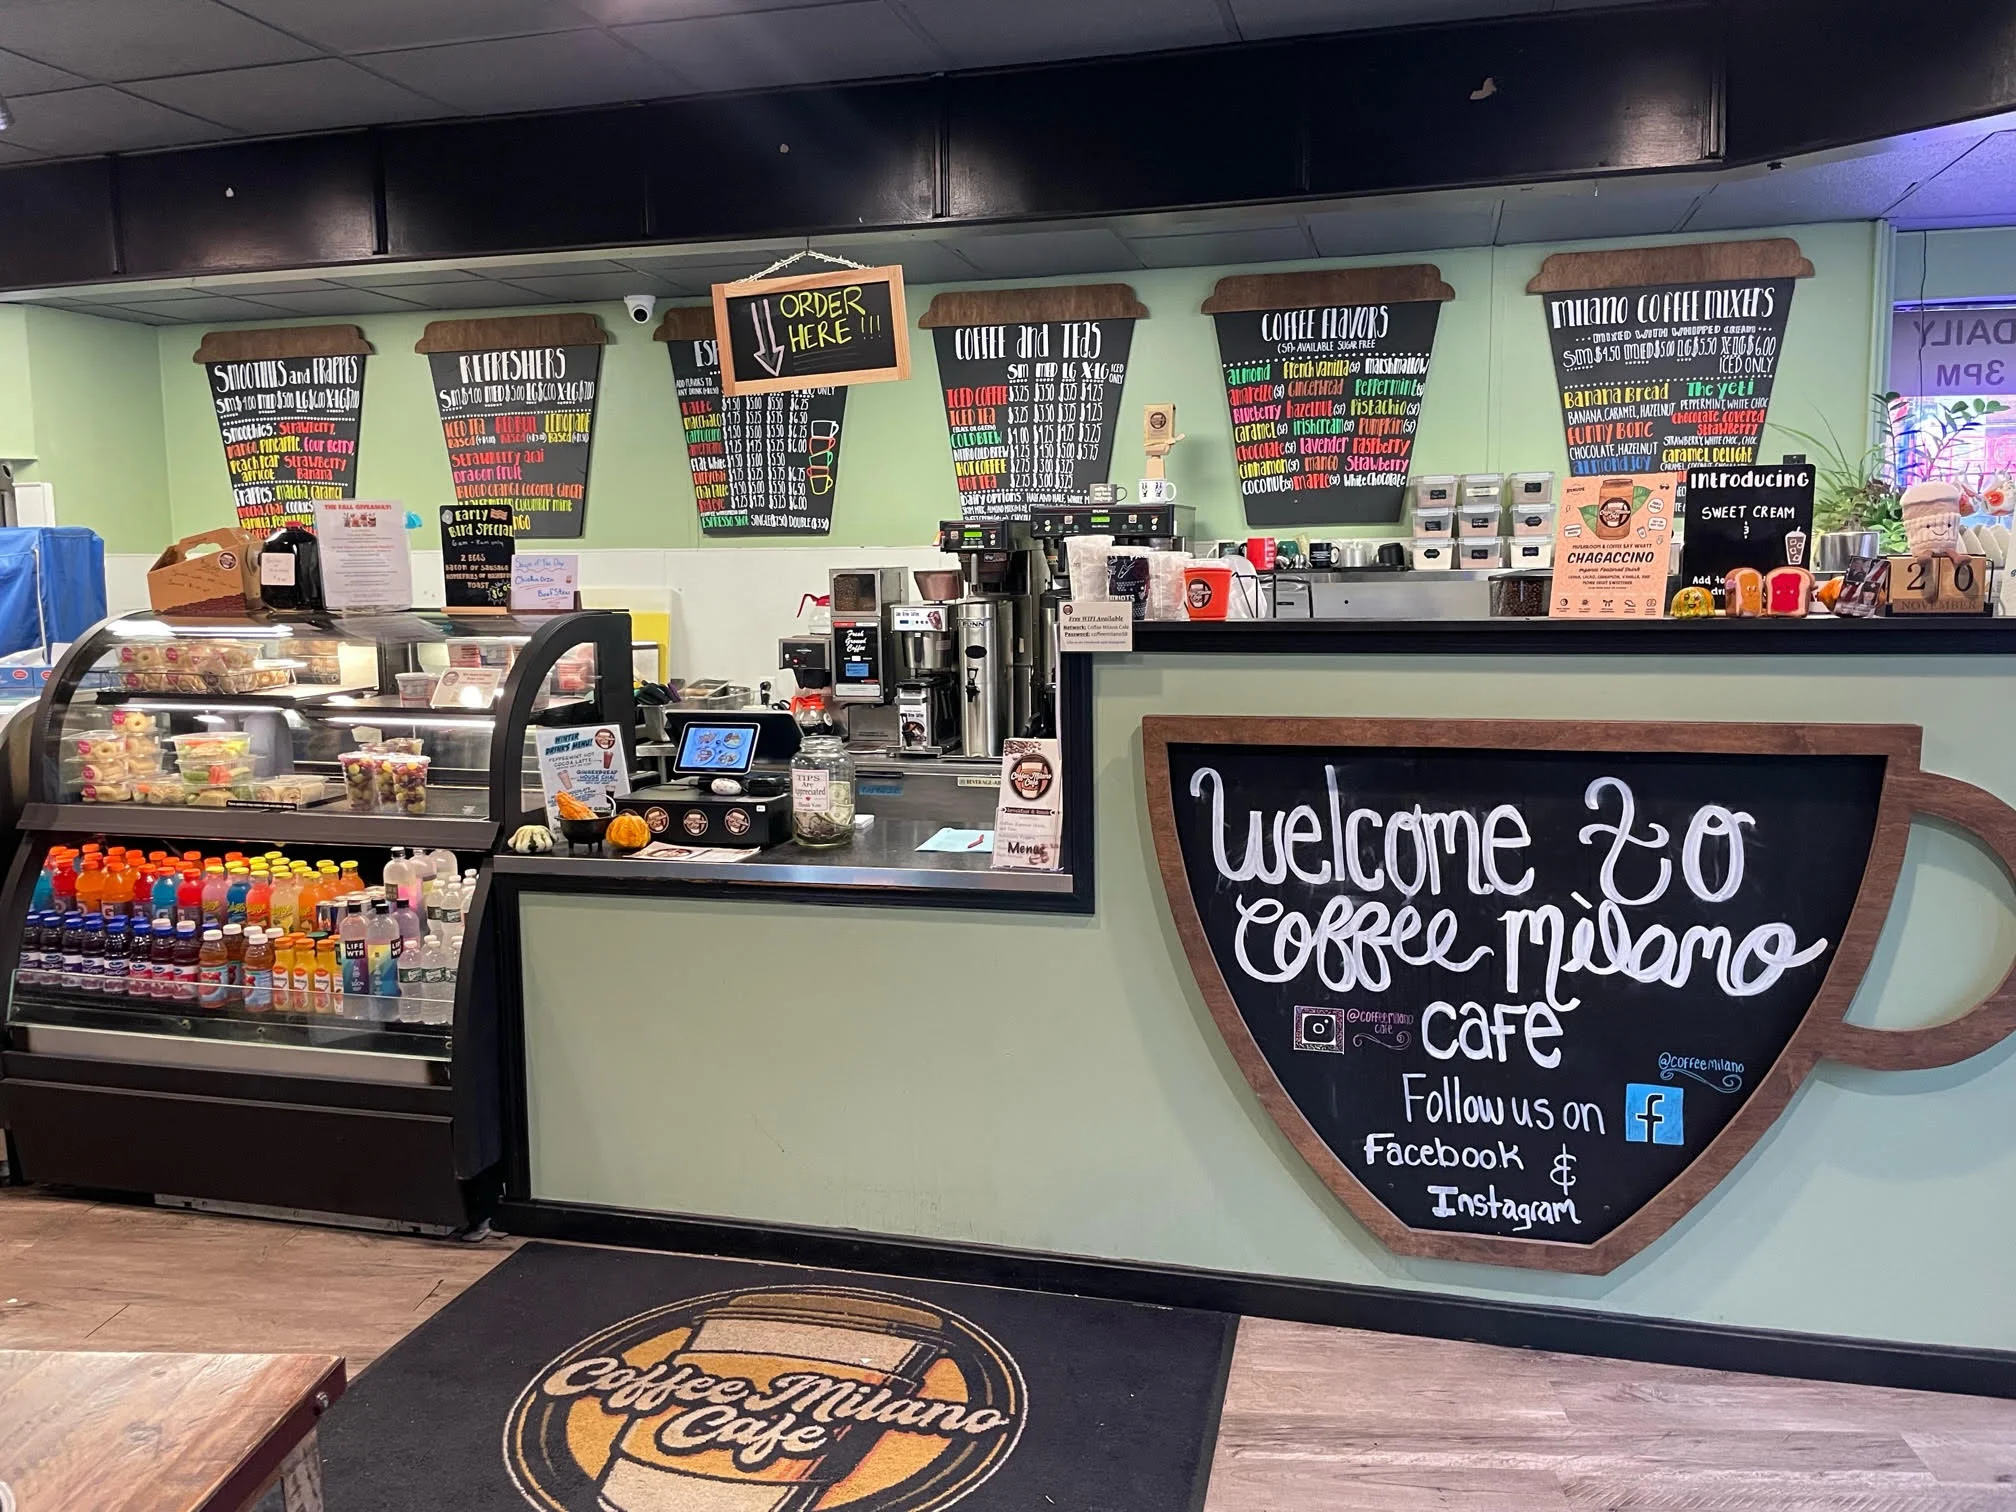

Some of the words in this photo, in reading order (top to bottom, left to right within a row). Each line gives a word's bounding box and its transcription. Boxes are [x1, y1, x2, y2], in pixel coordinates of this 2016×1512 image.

[779, 286, 865, 319] ORDER
[1638, 291, 1700, 323] COFFEE
[789, 317, 852, 352] HERE
[1262, 309, 1316, 341] COFFEE
[1593, 331, 1631, 343] MIXED
[1636, 328, 1668, 340] WITH
[1672, 326, 1720, 336] WHIPPED
[955, 326, 1006, 360] COFFEE
[1297, 342, 1333, 352] AVAILABLE
[1338, 341, 1357, 350] SUGAR
[1359, 339, 1375, 349] FREE
[459, 348, 566, 384] REFRESHERS
[1719, 357, 1741, 373] ICED
[1744, 357, 1774, 373] ONLY
[289, 368, 310, 384] and
[1109, 374, 1123, 384] ONLY
[1564, 387, 1621, 409] Banana
[1625, 383, 1669, 404] Bread
[1687, 382, 1713, 396] The
[1640, 403, 1675, 418] HAZELNUT
[1727, 399, 1748, 409] WHITE
[1619, 442, 1658, 455] HAZELNUT
[1702, 506, 1747, 520] SWEET
[1753, 506, 1795, 519] CREAM
[1568, 552, 1654, 563] CHAGACCINO
[1693, 576, 1711, 584] Add
[1907, 563, 1926, 590] 2
[1954, 564, 1973, 591] 0
[1902, 601, 1976, 609] NOVEMBER
[1189, 765, 1534, 898] Welcome
[1579, 776, 1758, 904] to
[1402, 1073, 1504, 1127] Follow
[1512, 1097, 1554, 1130] us
[1563, 1099, 1606, 1135] on
[1363, 1133, 1525, 1171] Facebook
[1427, 1184, 1582, 1231] Instagram
[543, 1357, 752, 1410] Coffee
[745, 1372, 1010, 1434] Milano
